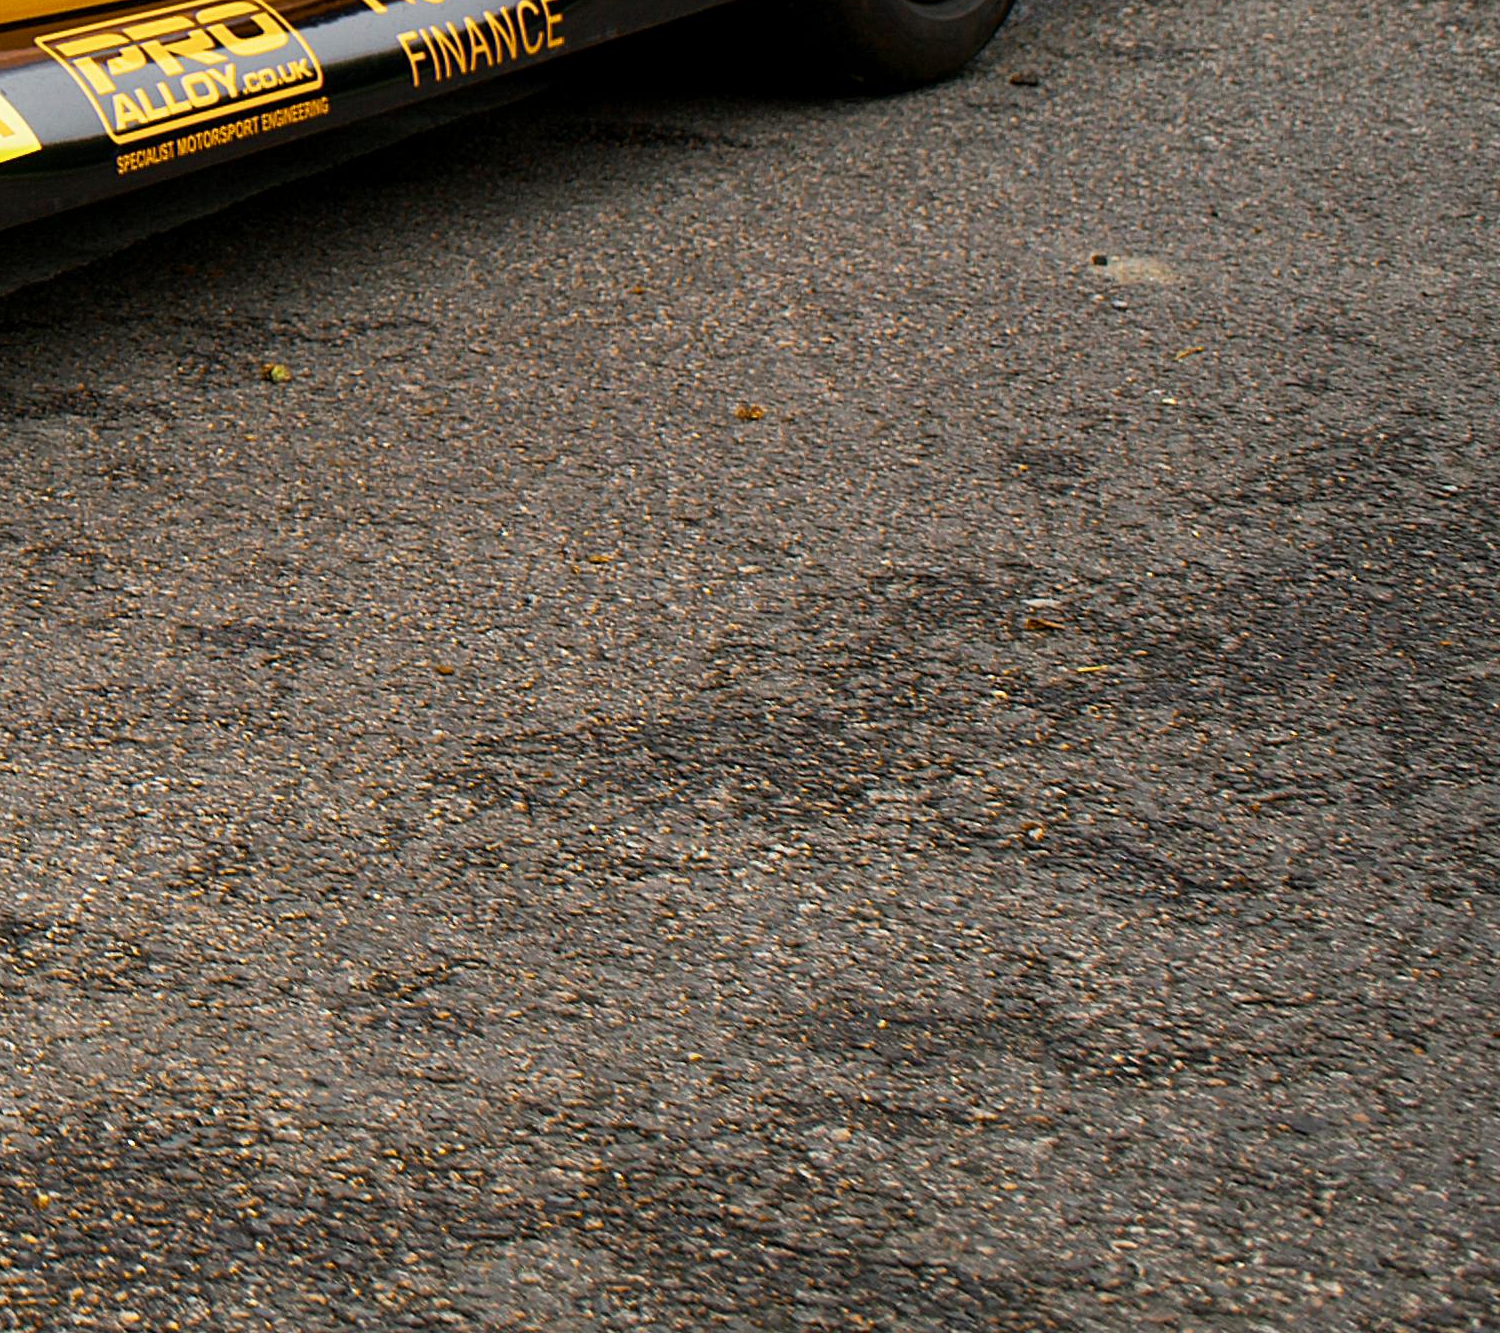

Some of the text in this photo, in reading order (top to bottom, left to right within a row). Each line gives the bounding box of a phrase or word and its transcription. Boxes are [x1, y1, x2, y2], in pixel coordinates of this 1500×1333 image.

[54, 0, 290, 96] PRO
[110, 56, 315, 132] ALLOY.CO.UK
[115, 95, 332, 176] SPECIALIST MOTORSPORT ENGINEERING
